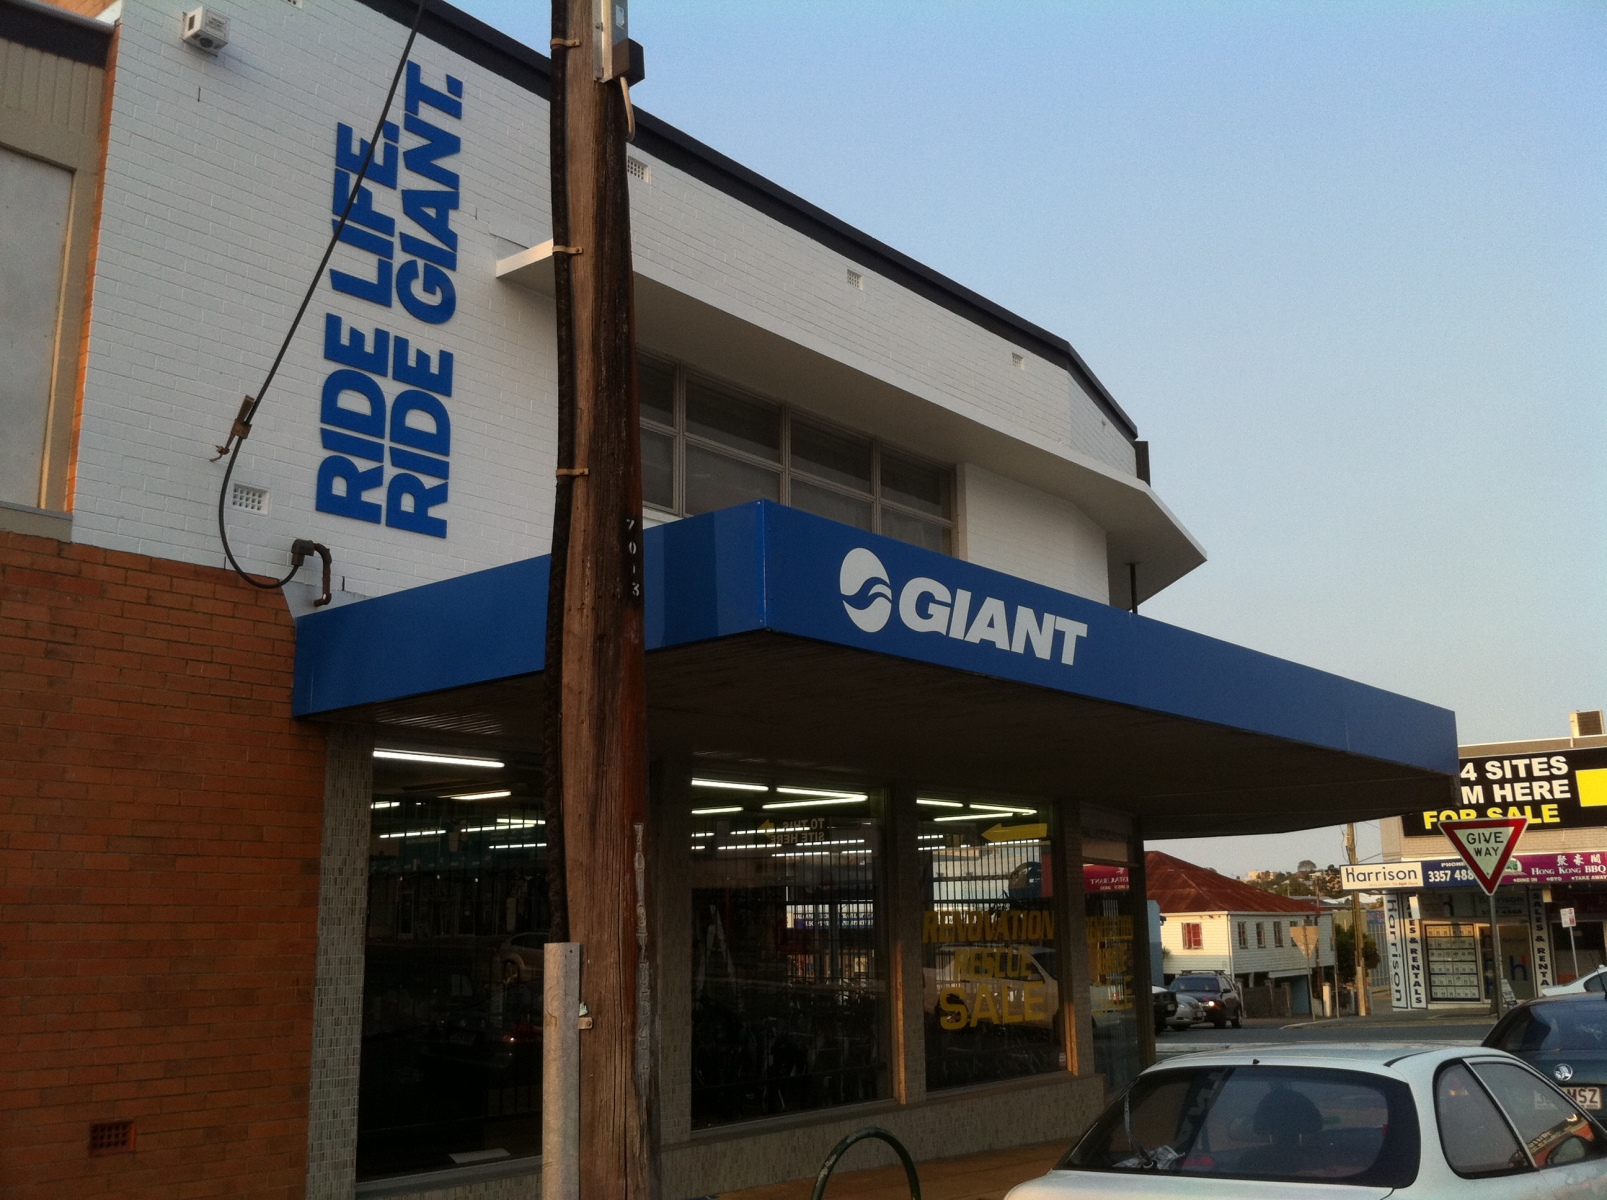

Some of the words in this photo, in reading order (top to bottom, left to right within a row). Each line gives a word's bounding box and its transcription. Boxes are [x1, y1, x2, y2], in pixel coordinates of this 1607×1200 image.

[396, 60, 463, 325] GIANT.
[329, 120, 400, 308] LIFE.
[315, 312, 390, 524] RIDE
[385, 335, 453, 539] RIDE
[626, 518, 640, 597] 7013
[899, 577, 1088, 666] GIANT
[1485, 755, 1569, 780] SITES
[1492, 779, 1571, 803] HERE
[1423, 809, 1477, 829] FOR
[1487, 804, 1560, 824] SALE
[1466, 831, 1504, 845] GIVE
[1473, 846, 1500, 857] WAY
[1346, 866, 1417, 882] harrison
[1428, 870, 1451, 882] 3357
[1454, 869, 1475, 881] 488
[1584, 864, 1607, 874] BBQ
[923, 909, 1056, 944] RENOVATION
[953, 945, 1033, 980] RESCUE
[1410, 948, 1423, 1004] RENTALS
[1537, 947, 1550, 985] RENTA
[940, 981, 1047, 1030] SALE
